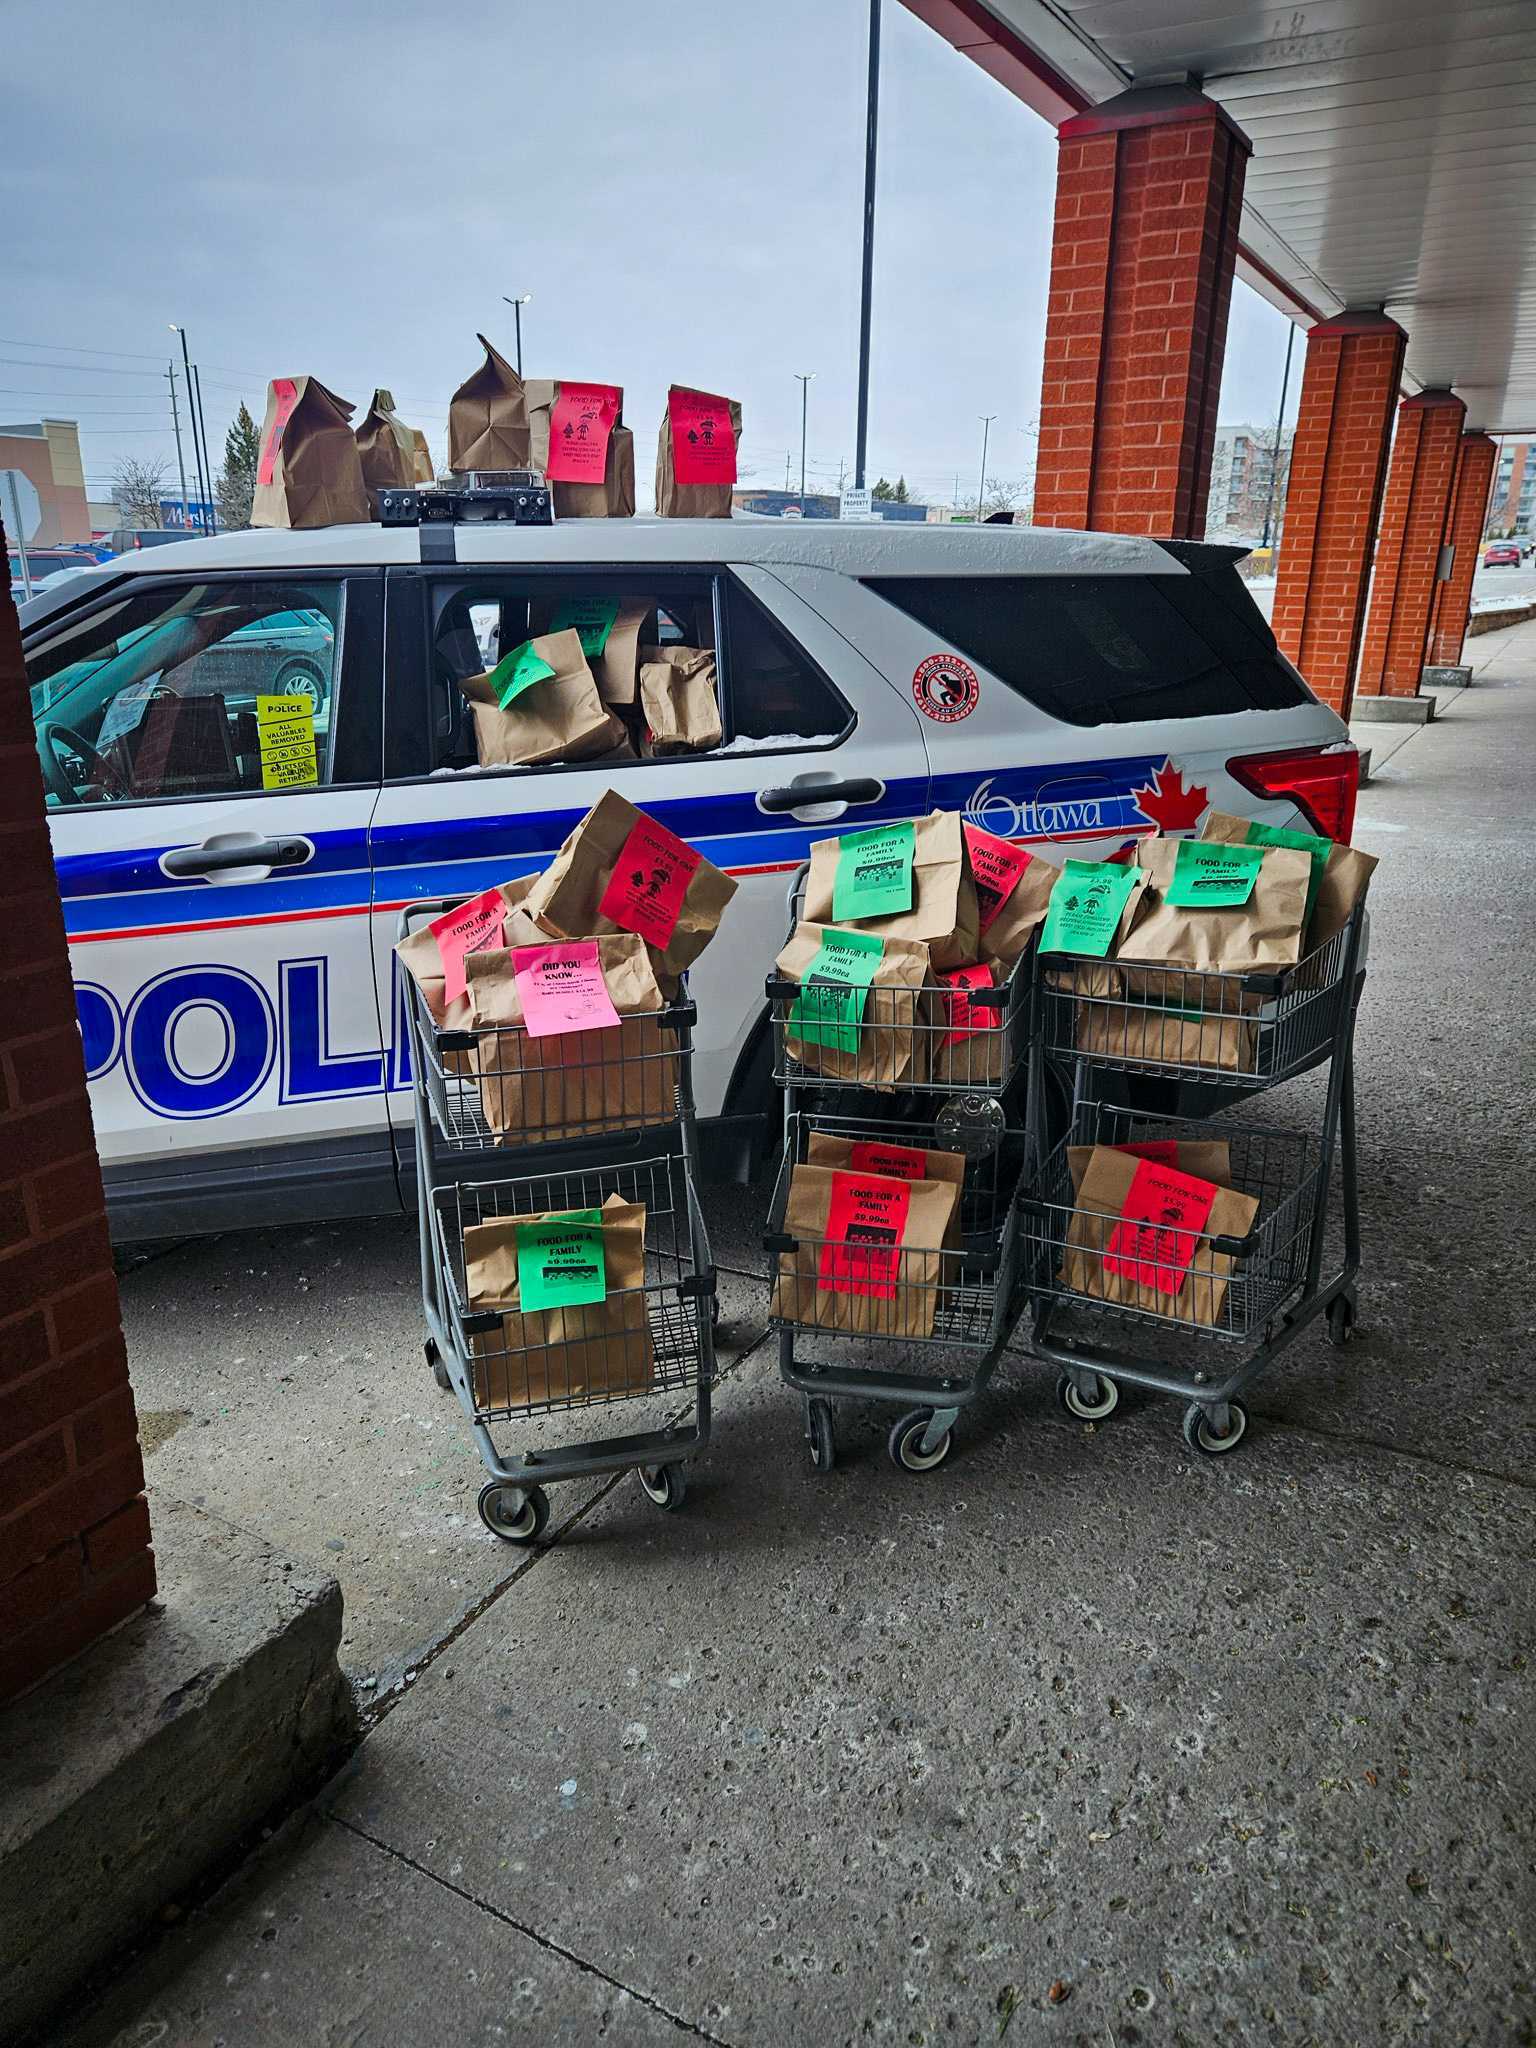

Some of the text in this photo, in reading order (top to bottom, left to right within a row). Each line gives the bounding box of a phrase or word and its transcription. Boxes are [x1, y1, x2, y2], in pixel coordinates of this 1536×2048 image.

[267, 704, 303, 713] POLICE
[266, 728, 307, 739] VALUABLES
[270, 734, 305, 745] REMOVED
[968, 782, 1104, 837] Ottawa
[857, 837, 905, 853] FOOD FOR A
[866, 847, 895, 858] FAMILY
[973, 846, 1019, 872] FOOD FOR A
[1194, 858, 1221, 867] FOOD
[976, 860, 1006, 876] FAMILY
[974, 870, 1000, 888] 9.99ea
[452, 906, 499, 936] FOOD FOR A
[465, 922, 492, 940] FAMILY
[826, 944, 846, 954] FOOD
[846, 948, 862, 958] FOR
[542, 960, 582, 972] DID YOU
[828, 956, 856, 966] FAMILY
[544, 971, 583, 981] KNOW...
[819, 964, 851, 978] $9.99ea
[870, 1156, 891, 1166] FOOD
[893, 1159, 911, 1168] FOR
[849, 1188, 873, 1199] FOOD
[875, 1191, 893, 1201] FOR
[858, 1200, 889, 1212] FAMILY
[854, 1213, 890, 1224] $9.99ea
[537, 1235, 562, 1247] FOOD
[565, 1232, 585, 1242] FOR
[549, 1245, 583, 1256] FAMILY
